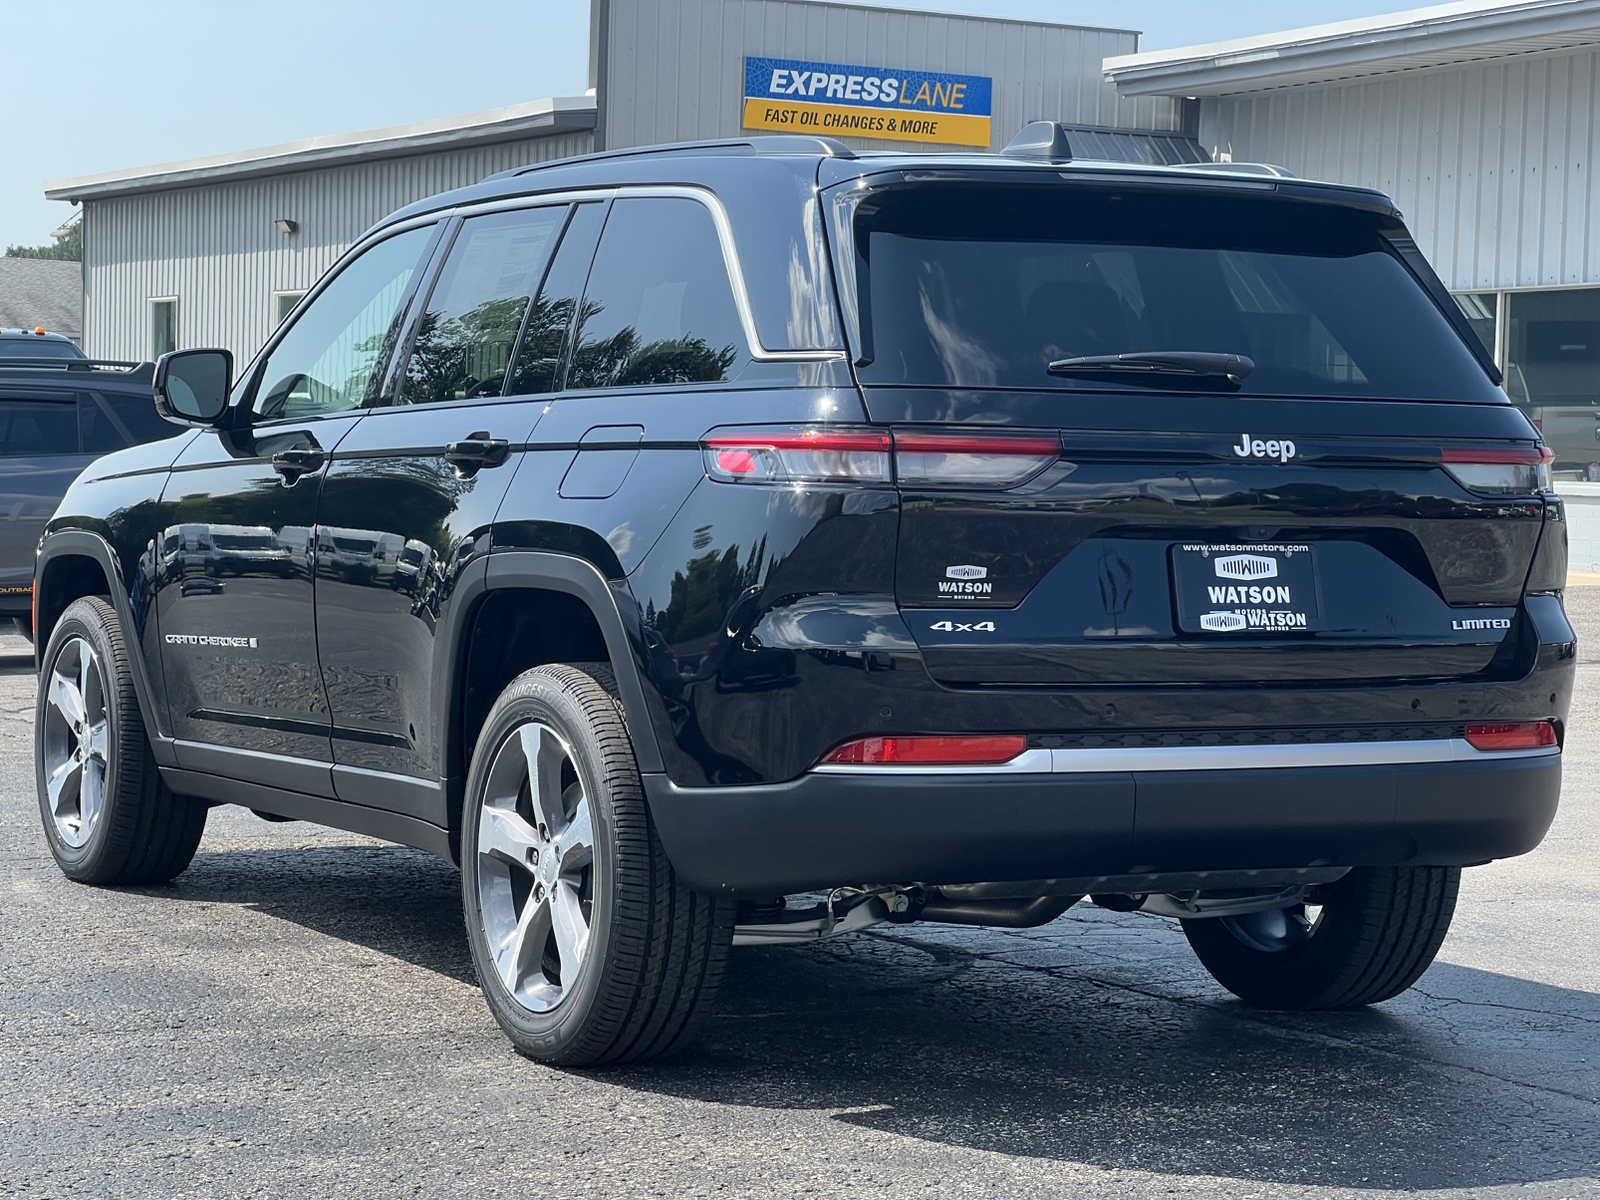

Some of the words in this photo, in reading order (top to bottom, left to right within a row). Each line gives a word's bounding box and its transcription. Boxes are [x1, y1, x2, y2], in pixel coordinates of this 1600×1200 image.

[764, 108, 798, 124] FAST
[800, 111, 819, 126] OIL
[823, 113, 884, 131] CHANGES
[886, 118, 897, 132] &
[900, 119, 938, 135] MORE
[1233, 433, 1296, 463] Jeep
[1182, 544, 1309, 552] www.watsonmotors.com
[938, 581, 992, 593] WATSON
[1207, 586, 1291, 604] WATSON
[929, 620, 997, 632] 4x4
[1246, 613, 1307, 626] WATSON
[1452, 618, 1511, 630] LIMITED
[165, 634, 197, 645] GRAND
[198, 636, 249, 648] CHEROKEE
